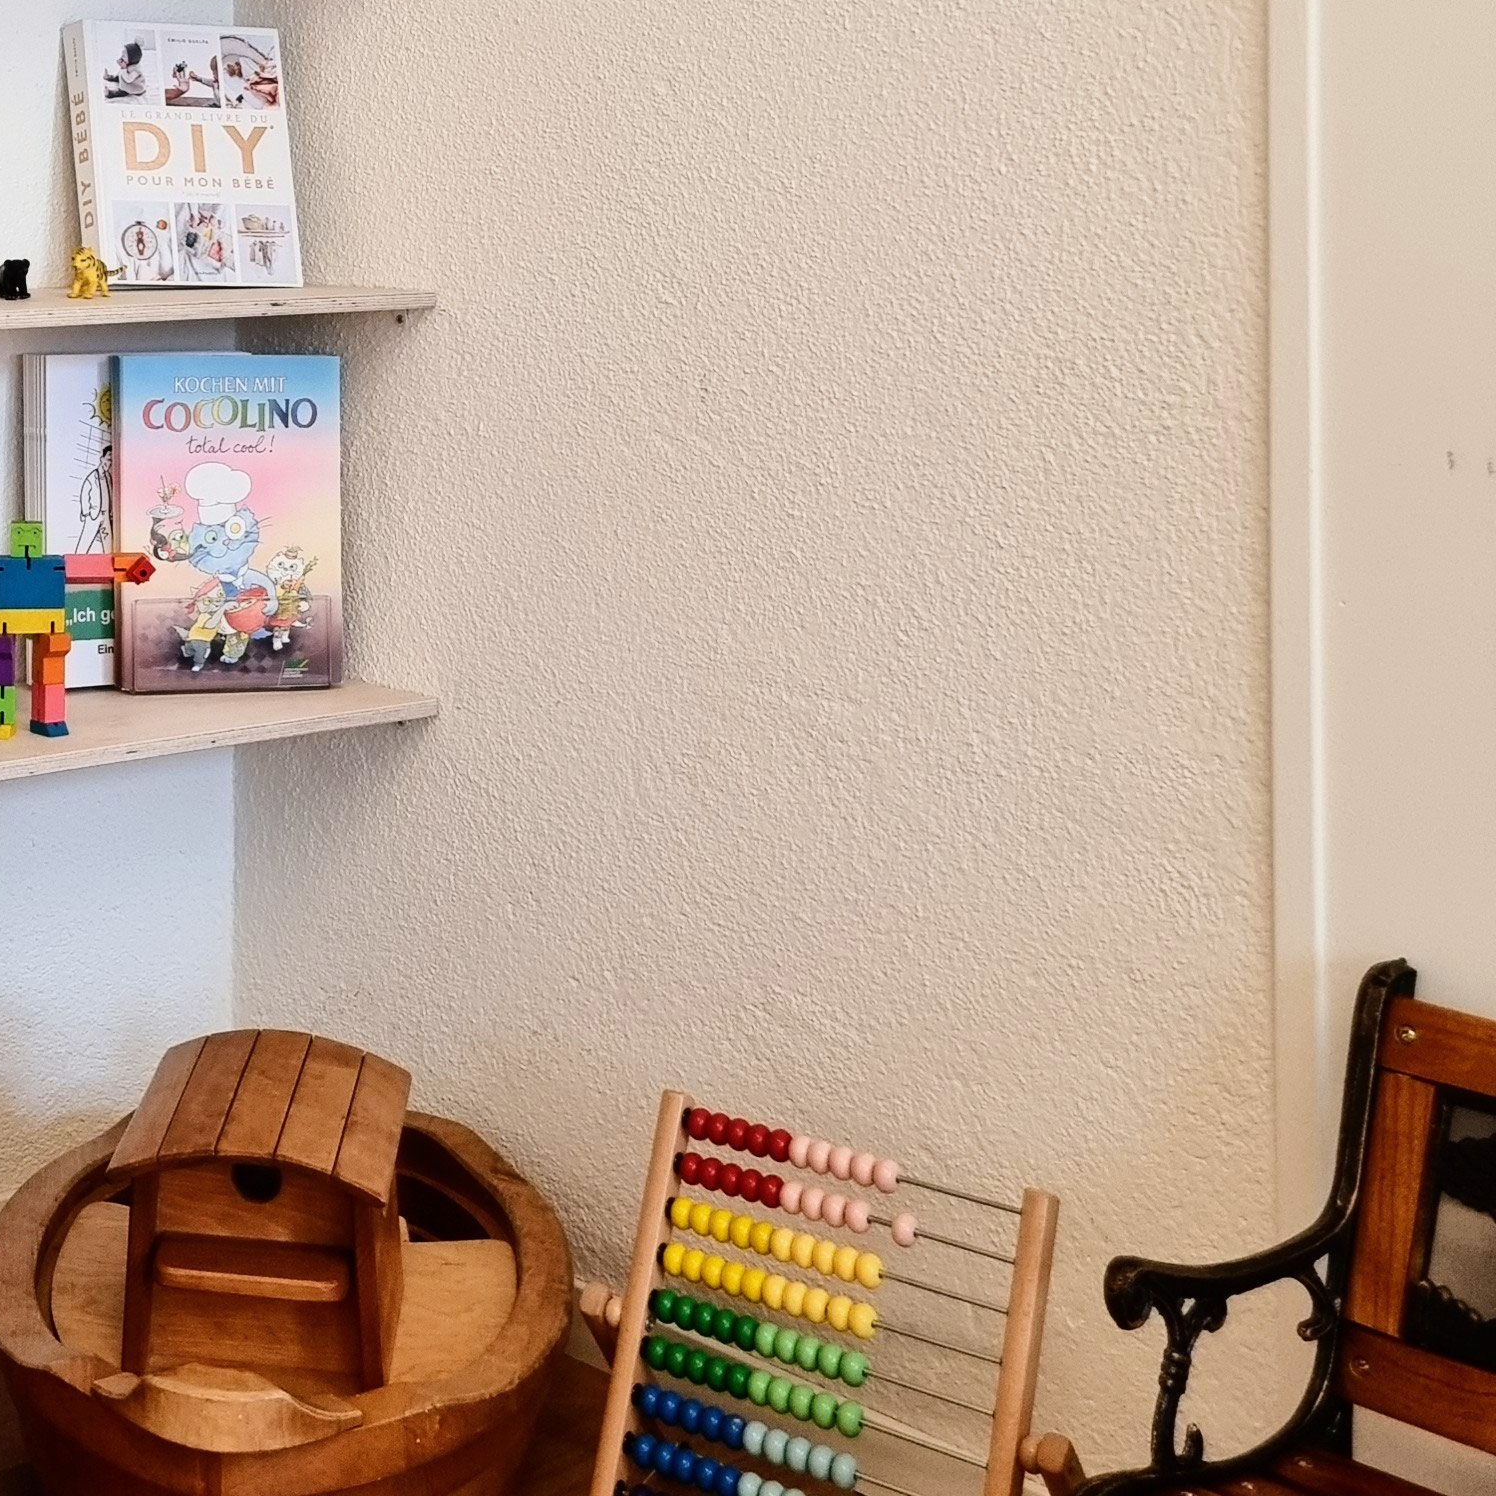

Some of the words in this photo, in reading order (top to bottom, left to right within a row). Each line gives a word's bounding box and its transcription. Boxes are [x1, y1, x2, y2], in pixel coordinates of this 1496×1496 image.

[72, 91, 89, 164] BÉBÉ
[122, 121, 268, 175] DIY
[81, 179, 95, 229] DIY
[174, 377, 250, 394] KOCHEN
[253, 377, 287, 393] MIT
[142, 395, 317, 433] COCOLINO
